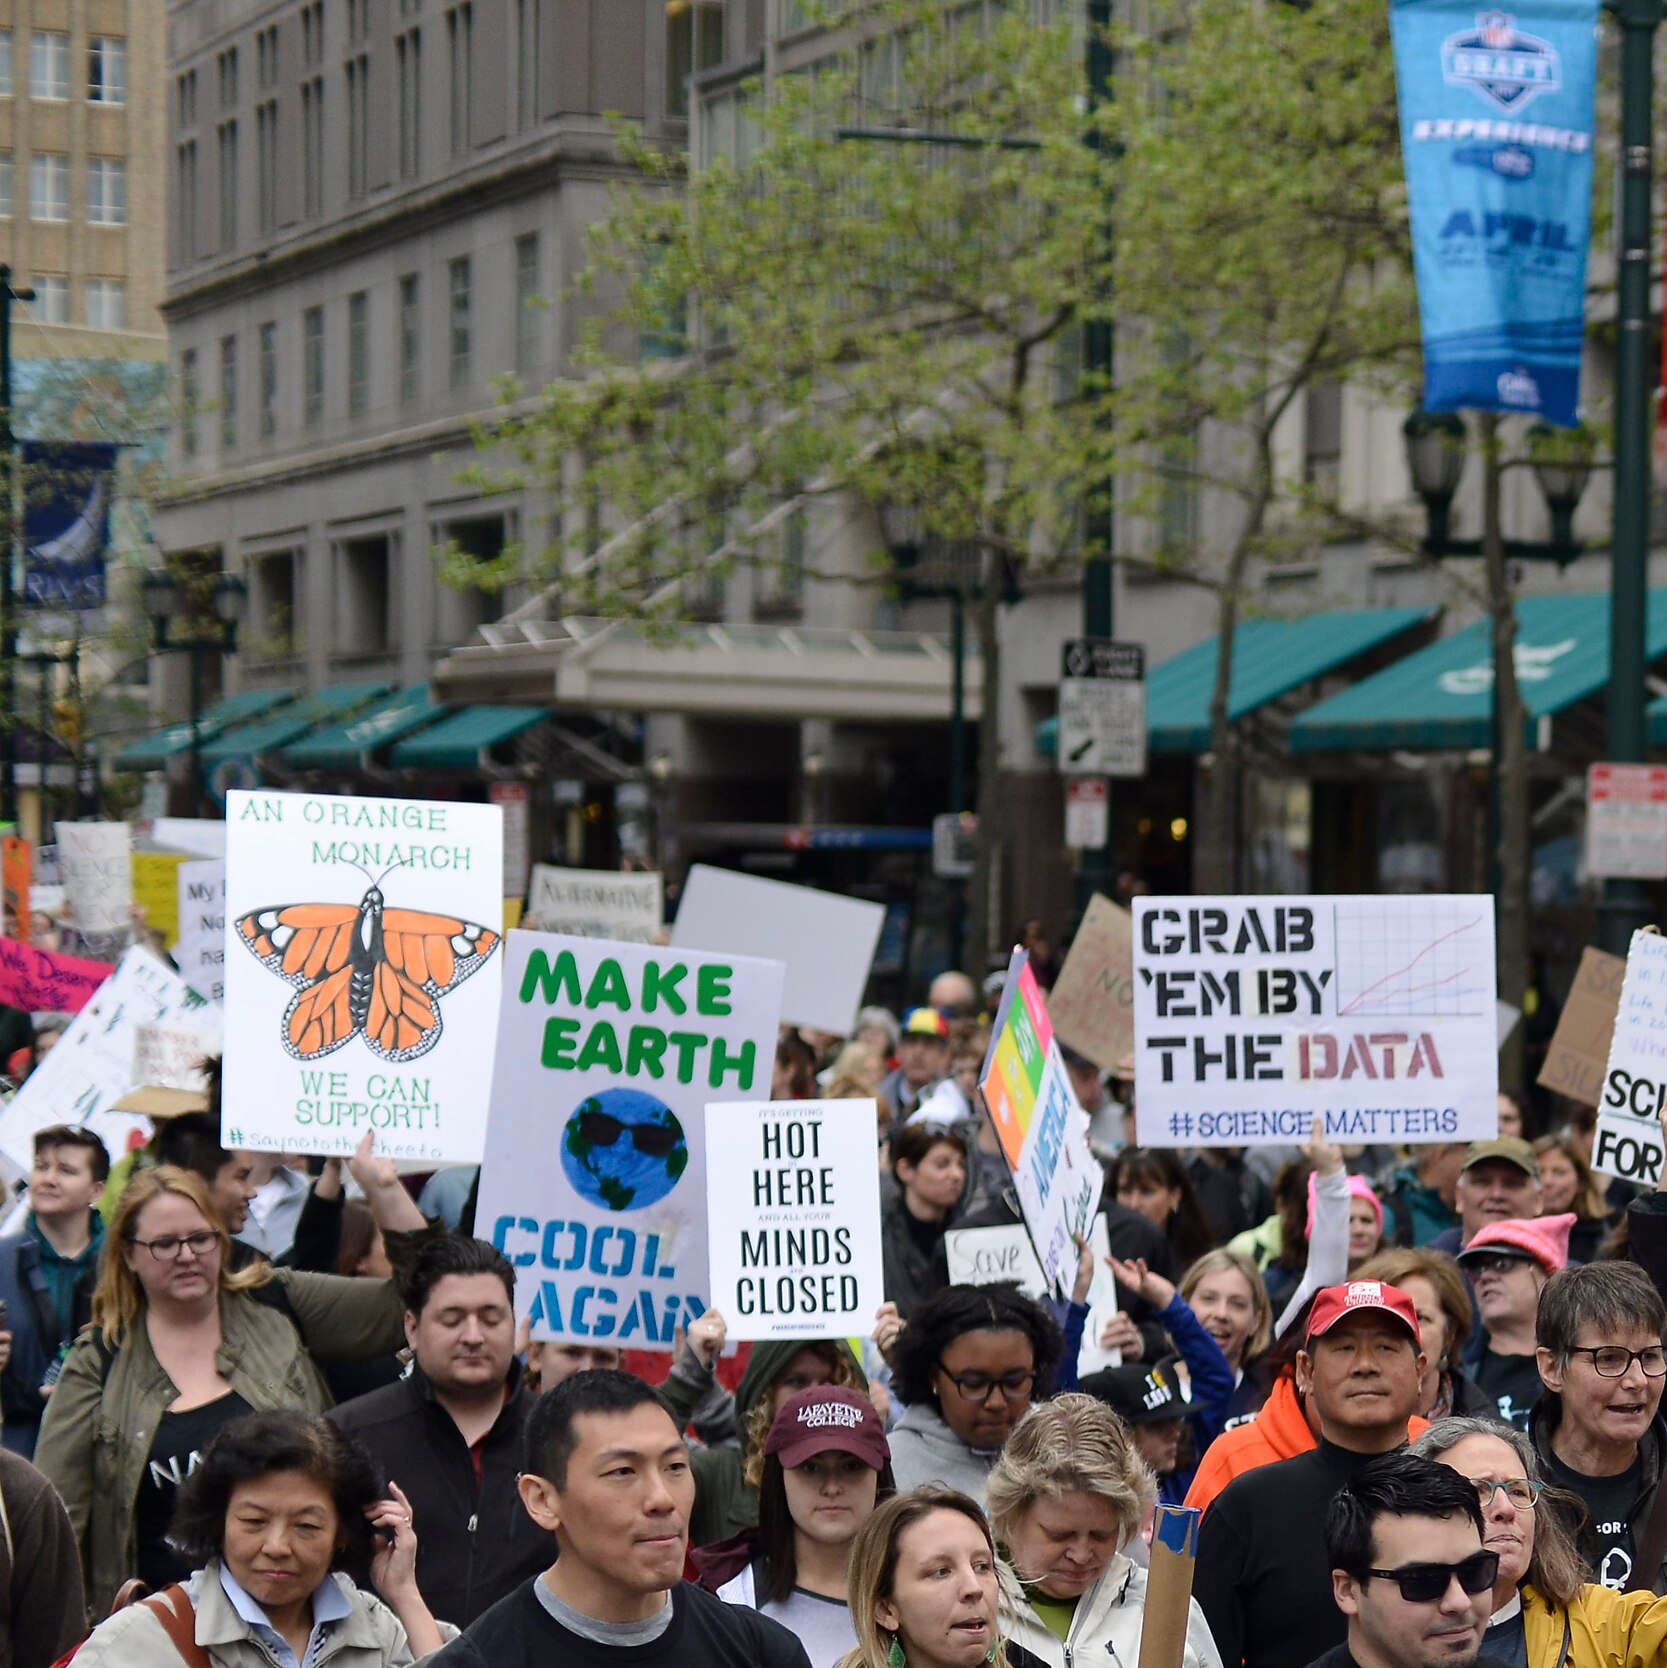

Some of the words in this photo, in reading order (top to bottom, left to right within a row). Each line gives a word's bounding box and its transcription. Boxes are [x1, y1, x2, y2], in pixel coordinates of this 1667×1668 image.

[1453, 53, 1551, 81] DRAFT
[241, 799, 283, 823] AN
[302, 801, 448, 832] ORANGE
[312, 840, 472, 870] MONARCH
[1142, 907, 1315, 955] GRAB
[519, 948, 735, 1017] MAKE
[1139, 967, 1241, 1016] 'EM
[1256, 969, 1333, 1015] BY
[541, 1016, 757, 1091] EARTH
[1147, 1034, 1283, 1082] THE
[1298, 1032, 1444, 1081] DATA
[301, 1070, 348, 1098] WE
[367, 1074, 430, 1102] CAN
[295, 1100, 440, 1130] SUPPORT!
[762, 1120, 822, 1160] HOT
[1596, 1130, 1663, 1183] FOR
[753, 1167, 835, 1207] HERE
[757, 1212, 780, 1222] AND
[804, 1211, 831, 1221] YOUR
[493, 1215, 676, 1280] COOL
[740, 1227, 852, 1268] MINDS
[952, 1233, 1021, 1275] Save
[736, 1275, 859, 1316] CLOSED
[797, 1402, 864, 1423] LAFAYETTE
[806, 1415, 856, 1428] COLLEGE
